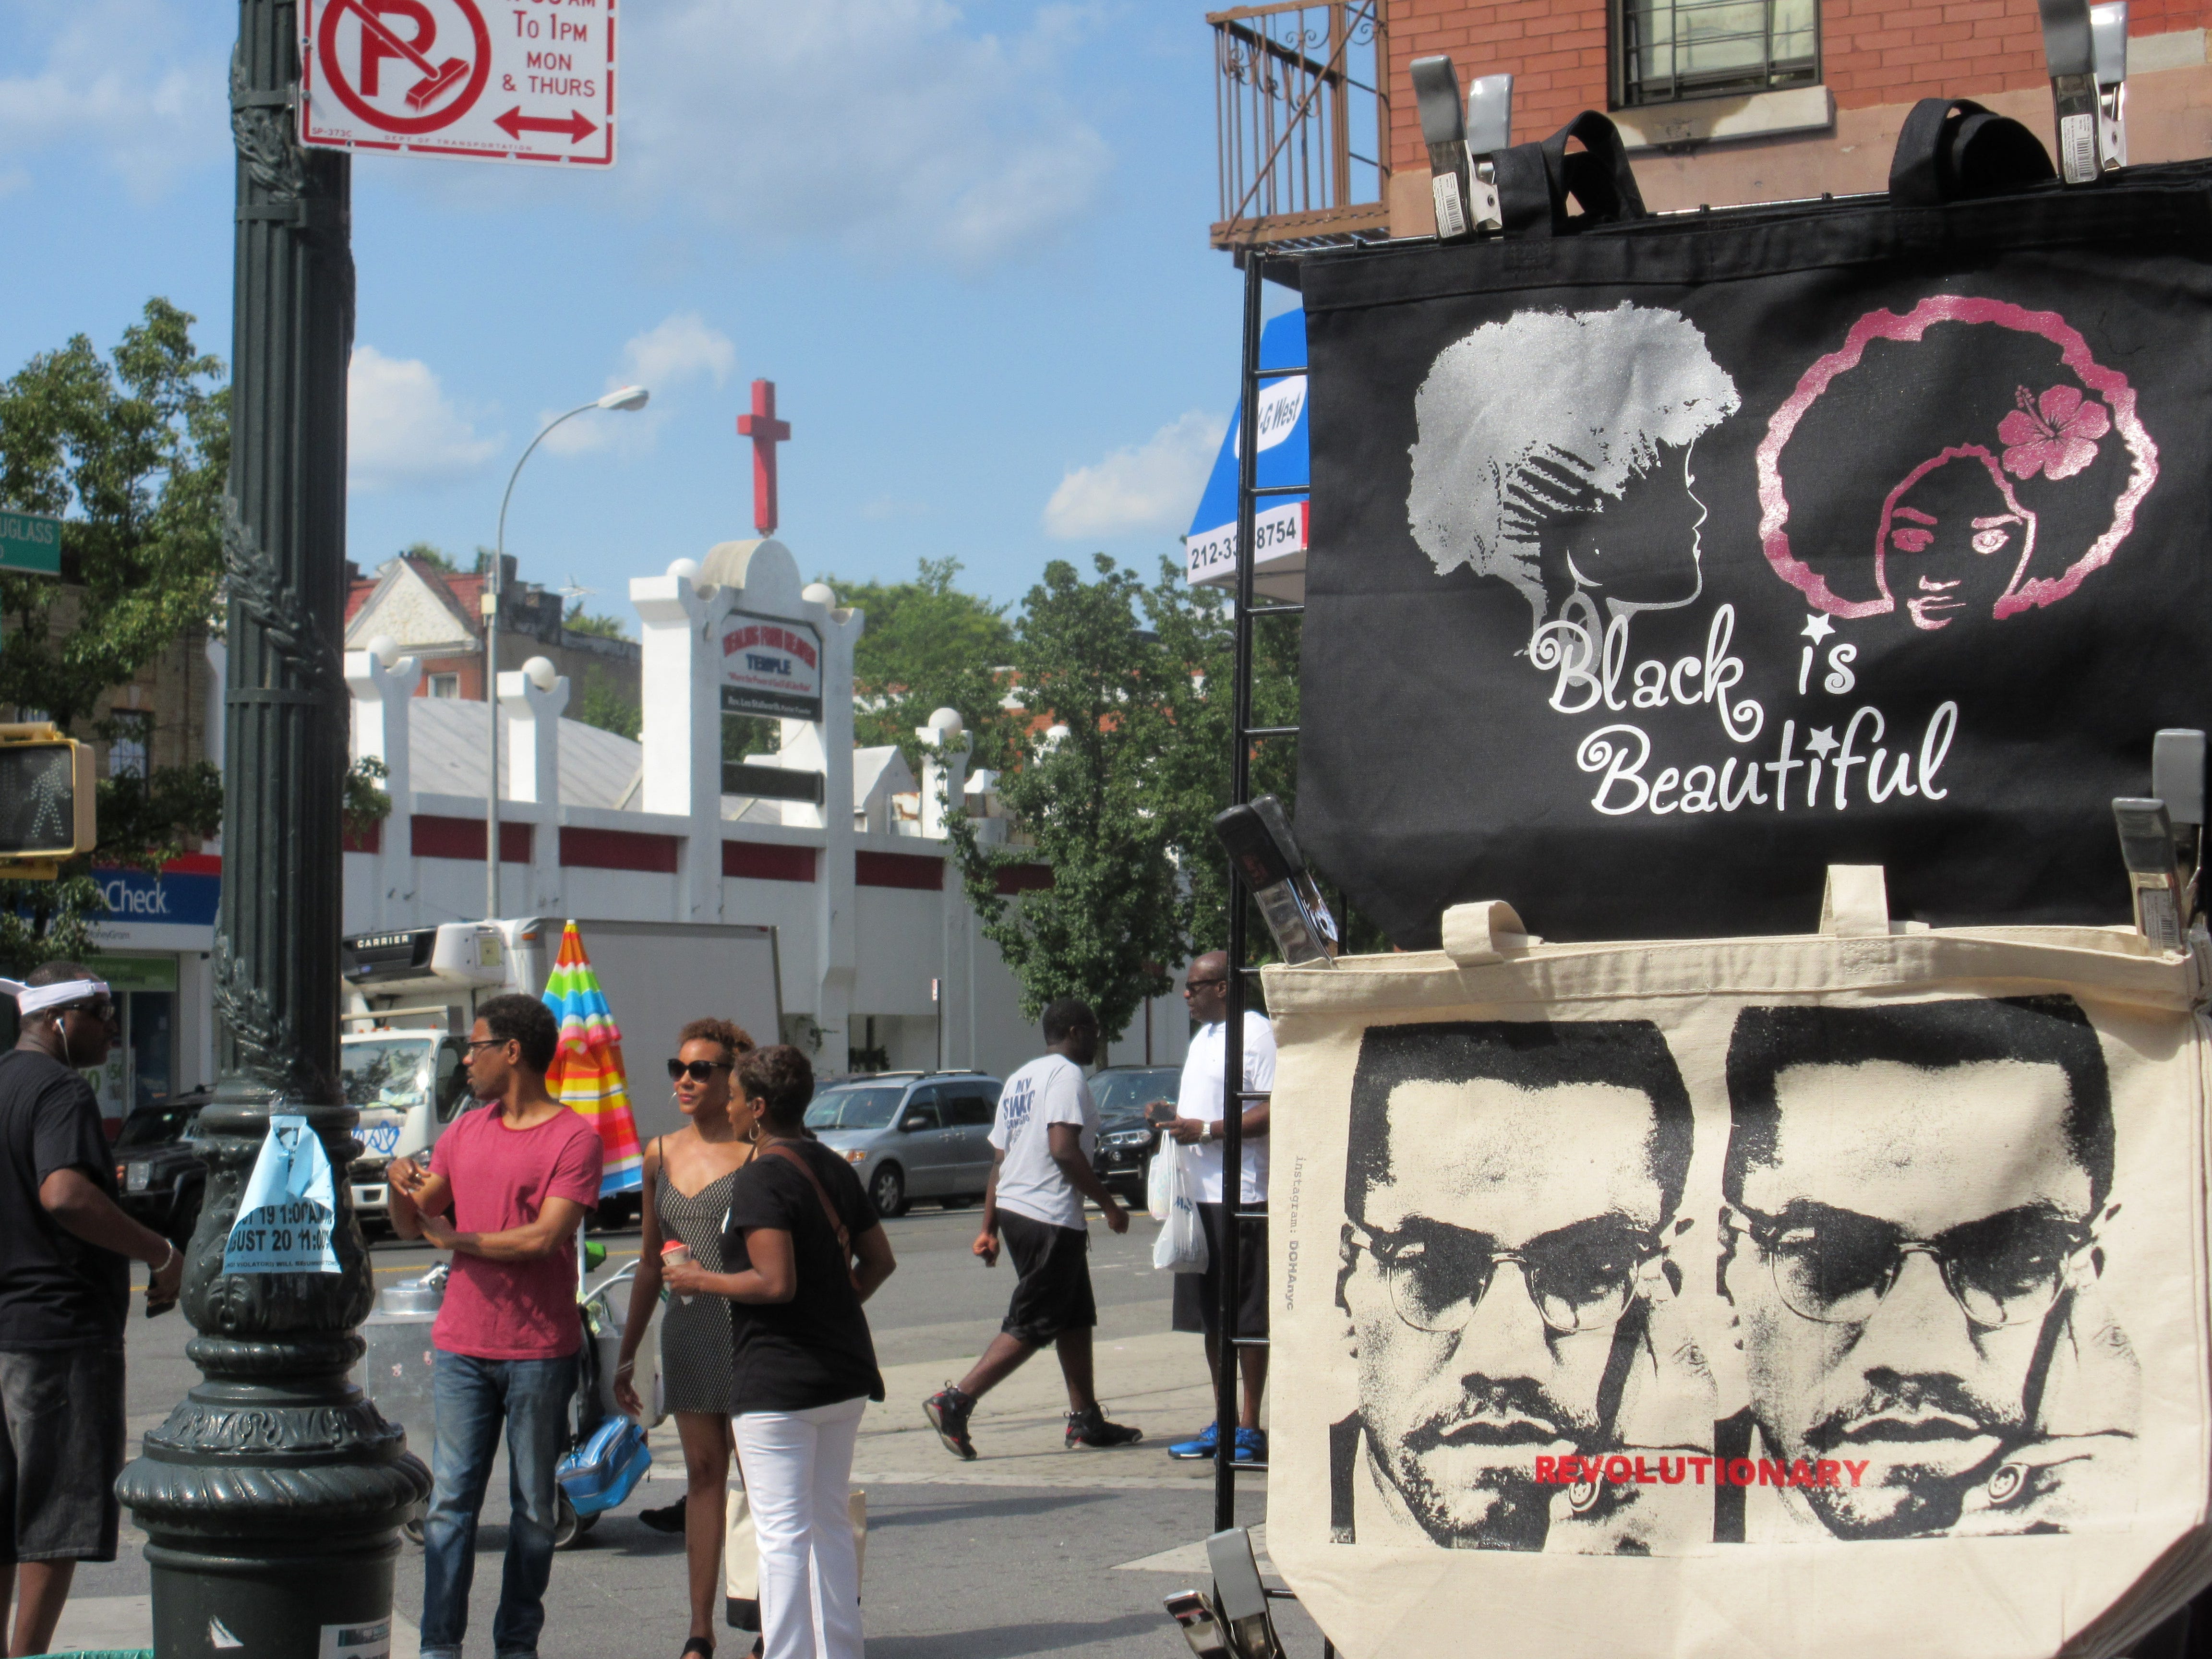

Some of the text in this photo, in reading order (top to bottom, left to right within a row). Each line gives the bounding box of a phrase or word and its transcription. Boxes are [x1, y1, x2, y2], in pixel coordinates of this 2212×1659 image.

[550, 13, 587, 42] 1PM
[527, 51, 572, 72] MON
[503, 74, 596, 97] & THURS
[437, 138, 532, 151] TRANSPORTATION
[1272, 391, 1301, 430] West
[1529, 603, 1857, 742] Black is
[1575, 700, 1958, 816] Beautiful
[357, 935, 409, 948] CARRIER
[1289, 1156, 1306, 1233] instagram:
[272, 1229, 292, 1251] 20
[1536, 1455, 1871, 1488] REVOLUTIONARY
